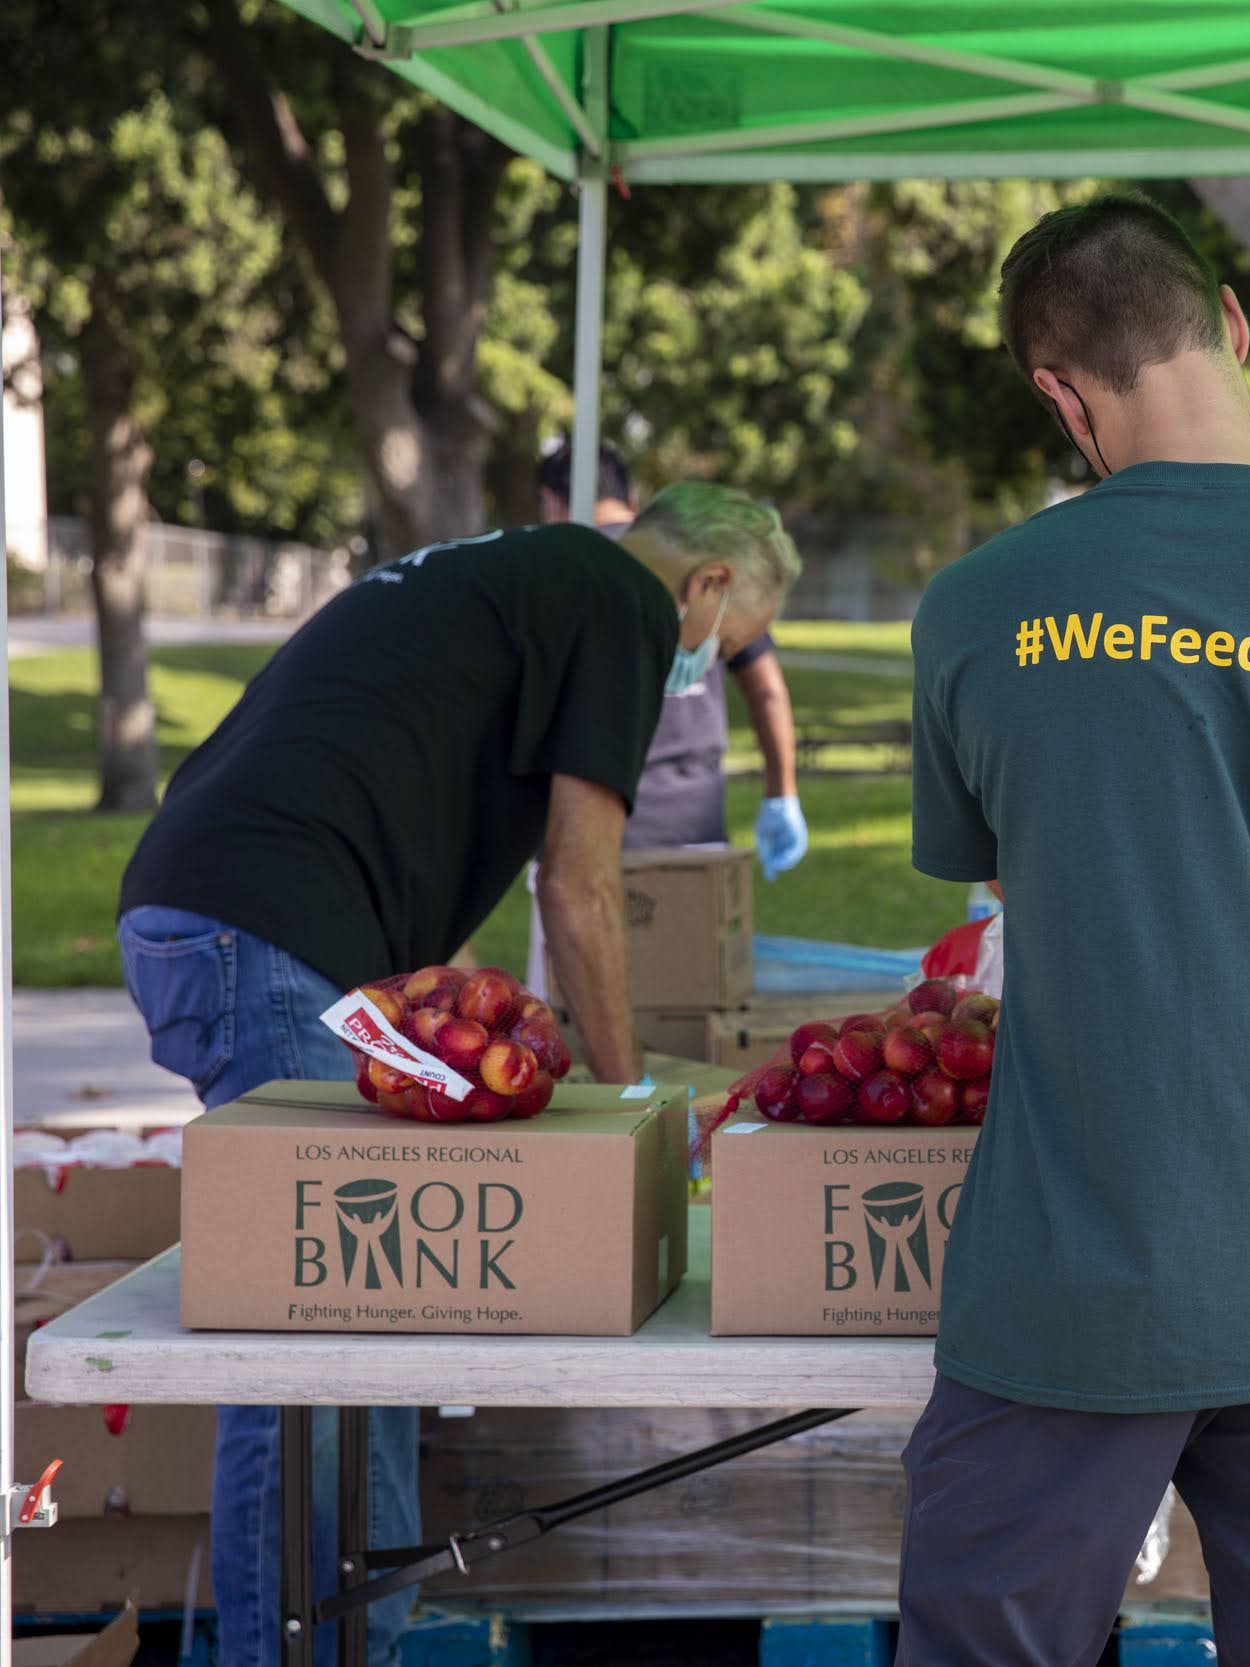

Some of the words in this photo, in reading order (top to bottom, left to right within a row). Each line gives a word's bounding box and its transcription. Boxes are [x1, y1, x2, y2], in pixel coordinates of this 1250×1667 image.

[295, 1144, 332, 1161] LOS
[336, 1145, 422, 1163] ANGELES
[426, 1146, 524, 1164] REGIONAL
[823, 1148, 859, 1165] LOS
[864, 1148, 947, 1165] ANGELES
[287, 1303, 352, 1323] Fighting
[356, 1304, 416, 1324] Hunger.
[420, 1305, 473, 1324] Giving
[476, 1305, 523, 1325] Hope.
[822, 1306, 883, 1326] Fighting
